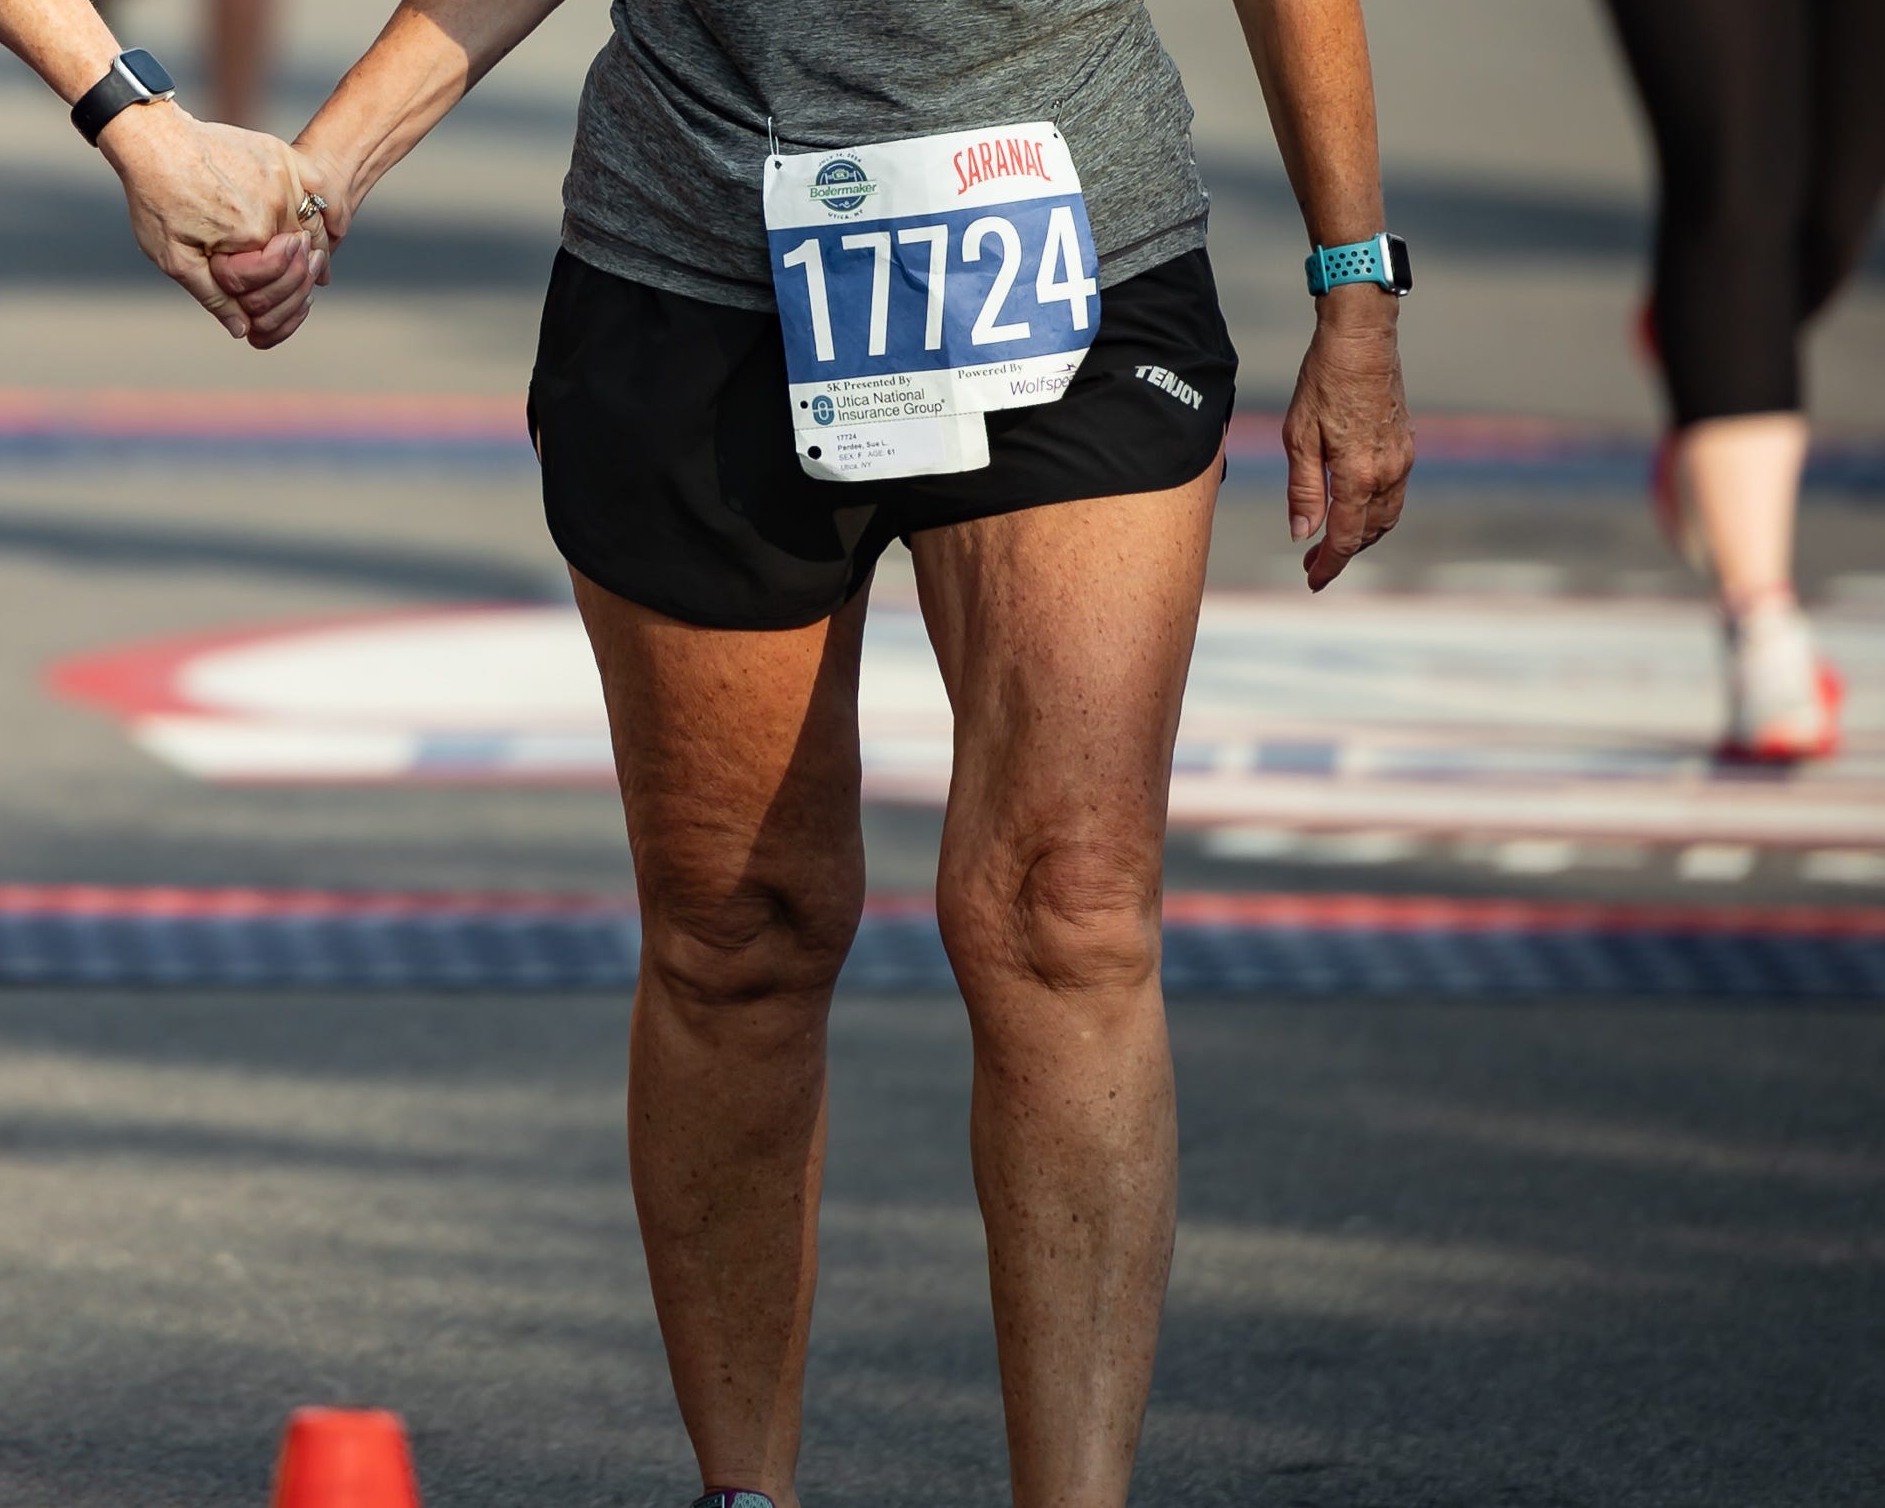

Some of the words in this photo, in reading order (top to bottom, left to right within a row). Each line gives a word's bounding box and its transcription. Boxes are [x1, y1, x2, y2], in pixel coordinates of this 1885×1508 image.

[953, 138, 1052, 195] SARANAC
[810, 184, 877, 198] Boilermaker
[782, 205, 1097, 362] 17724
[957, 364, 1006, 379] Powered
[1010, 363, 1023, 374] By
[827, 383, 841, 392] 5K
[843, 377, 896, 391] Presented
[898, 375, 912, 387] By
[1135, 365, 1203, 411] TENJOY
[836, 395, 870, 409] Utica
[874, 388, 925, 404] National
[838, 407, 900, 421] Insurance
[836, 433, 857, 441] 17724
